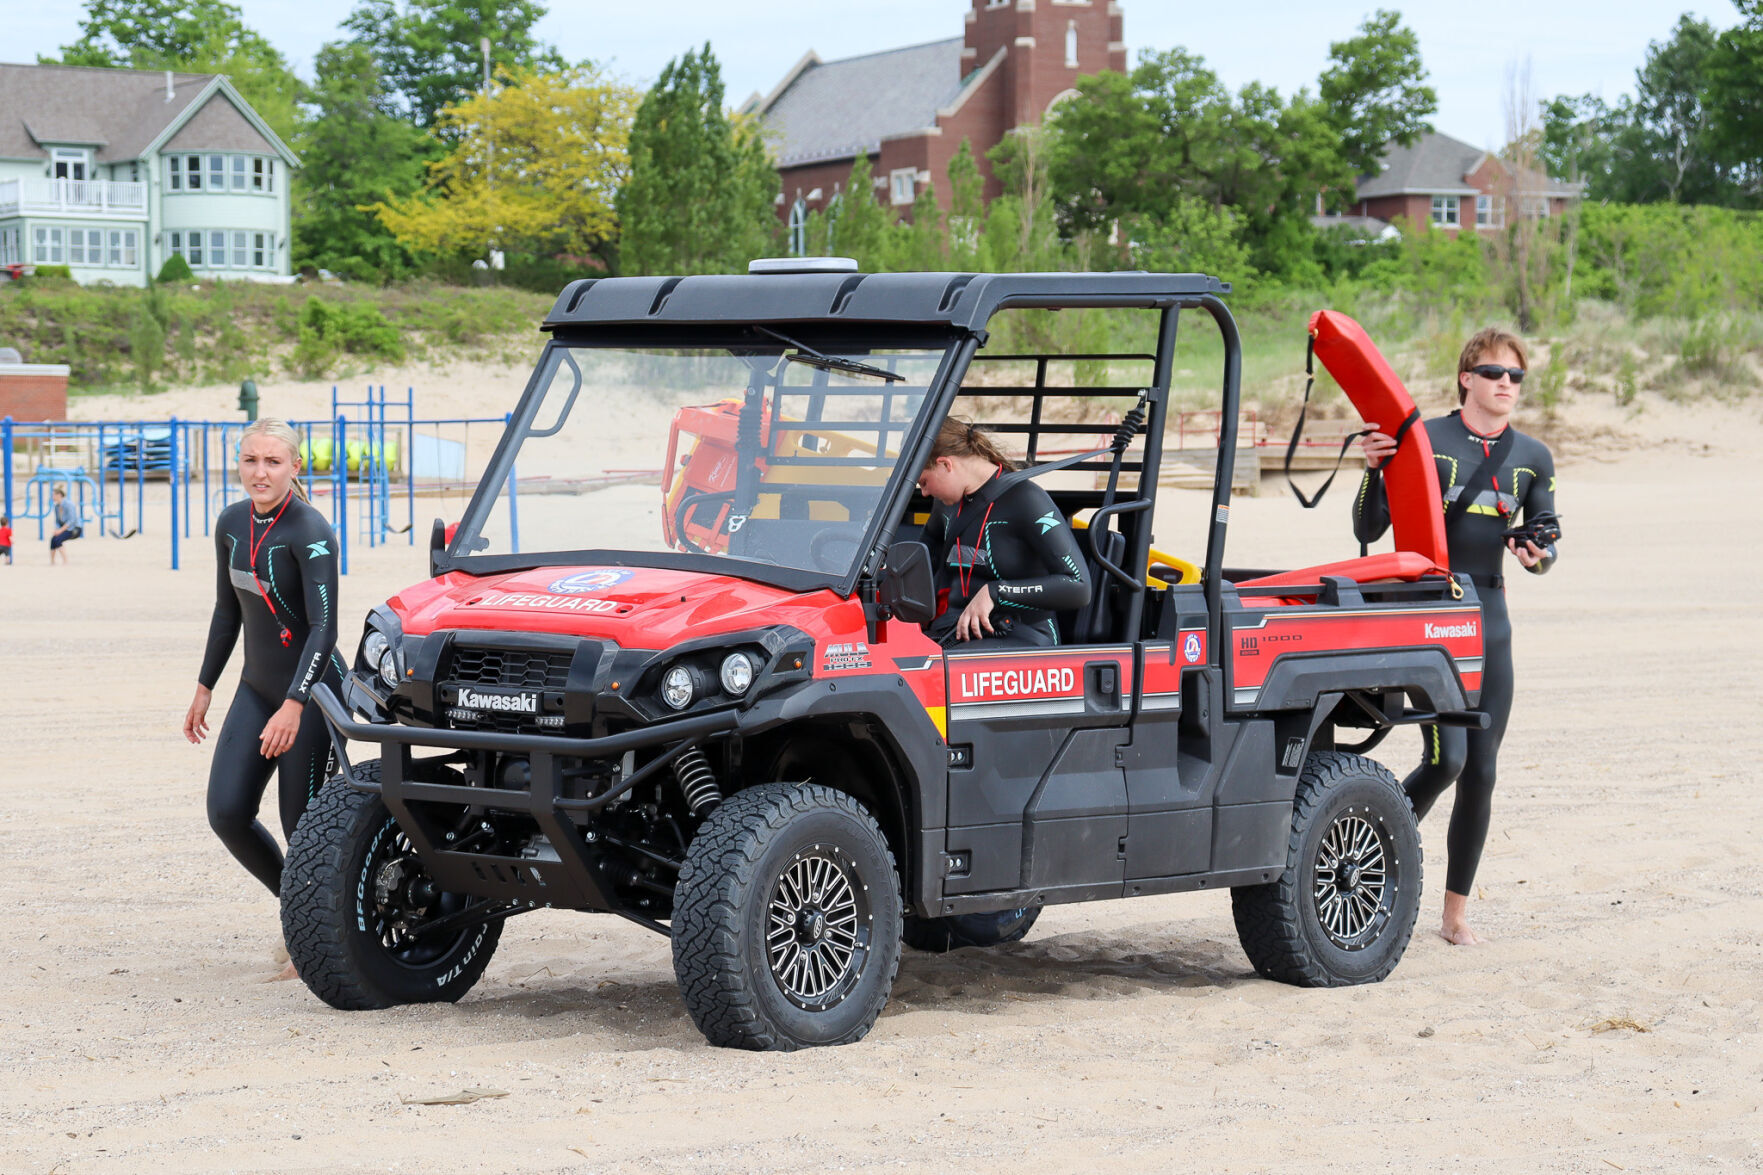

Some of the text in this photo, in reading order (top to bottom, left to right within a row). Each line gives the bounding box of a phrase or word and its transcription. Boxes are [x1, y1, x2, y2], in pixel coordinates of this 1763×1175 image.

[480, 595, 618, 612] LIFEGUARD
[1241, 634, 1303, 649] HD 1000
[1425, 621, 1477, 638] Kawasaki
[298, 652, 322, 694] XTERRA
[961, 667, 1075, 697] LIFEGUARD
[458, 688, 537, 712] Kawasaki
[356, 816, 397, 932] BFGoodric
[436, 922, 489, 987] rain T/A
